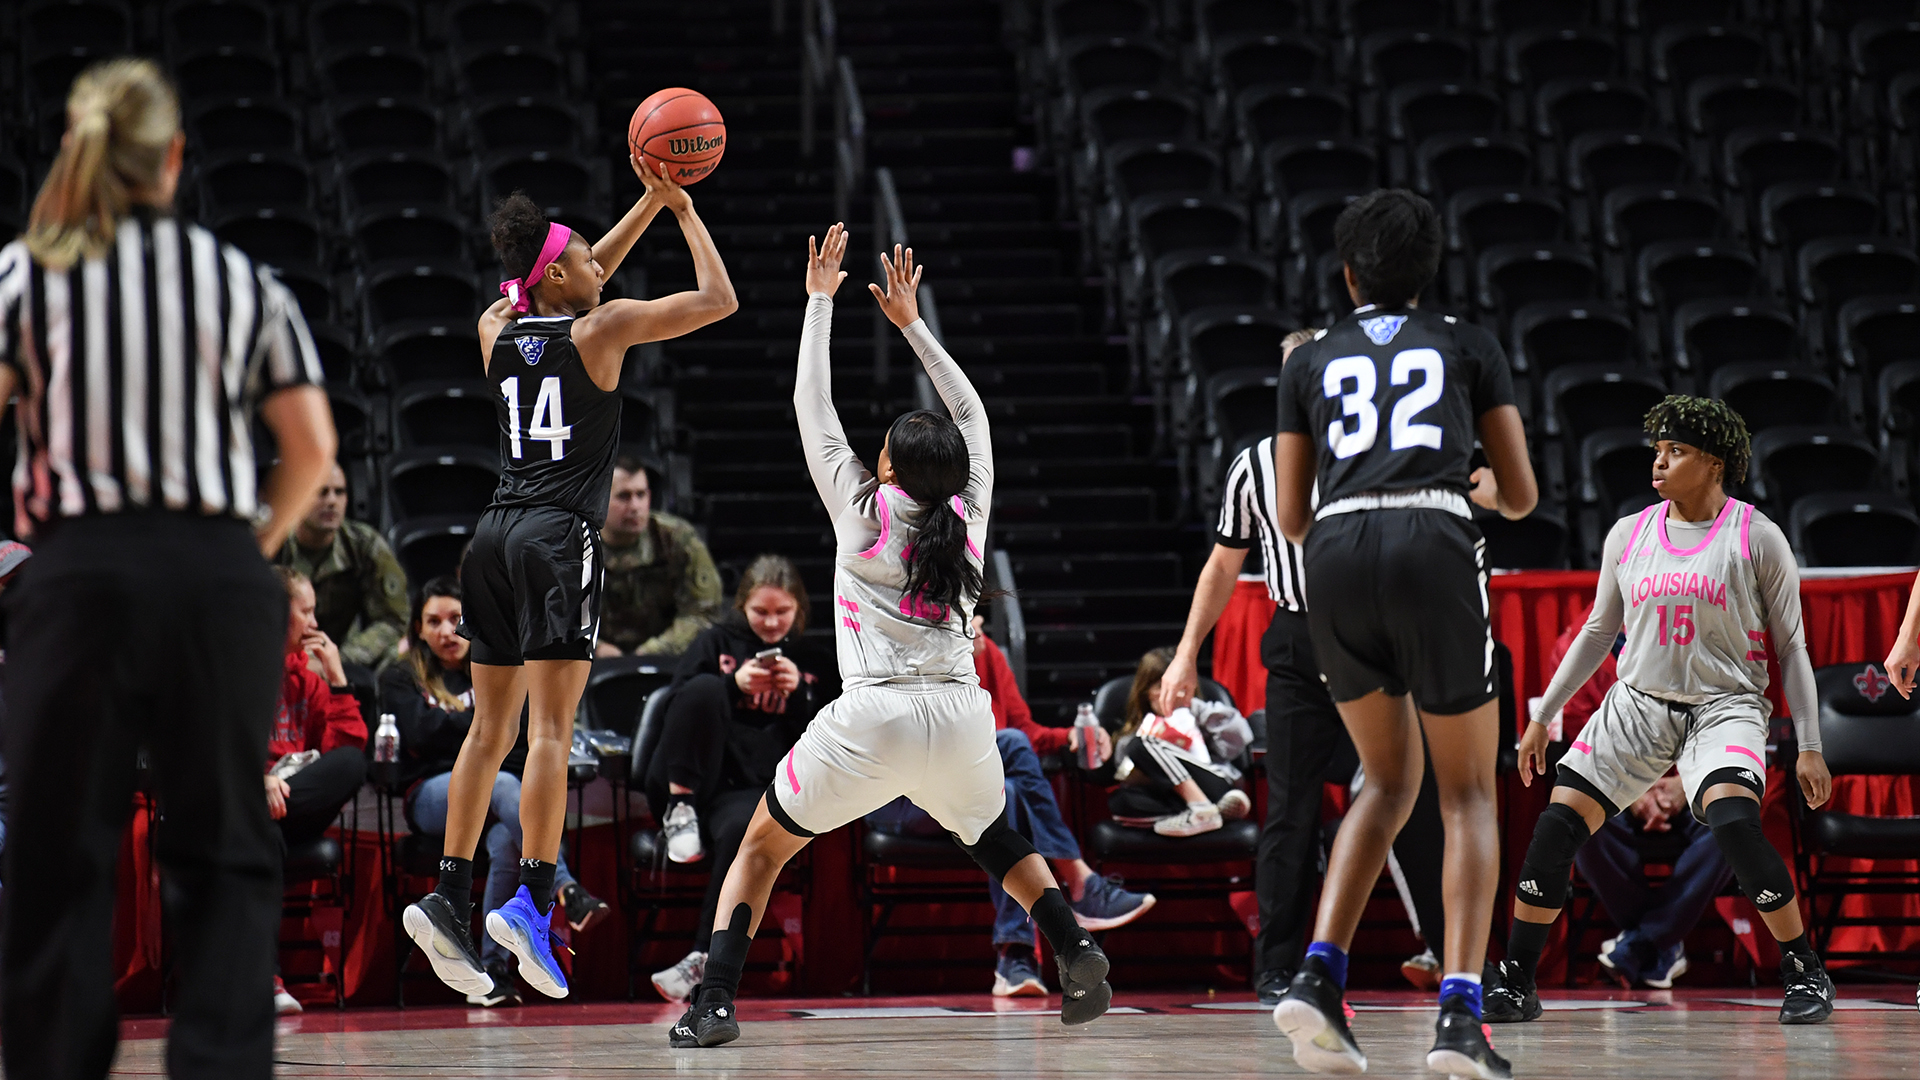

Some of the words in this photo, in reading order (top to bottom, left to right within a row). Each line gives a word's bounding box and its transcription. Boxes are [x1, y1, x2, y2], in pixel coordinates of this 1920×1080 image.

[668, 135, 723, 155] Wilson
[499, 375, 573, 460] 14
[1322, 346, 1445, 460] 32
[1631, 572, 1727, 612] LOUISIANA
[1656, 605, 1695, 646] 15
